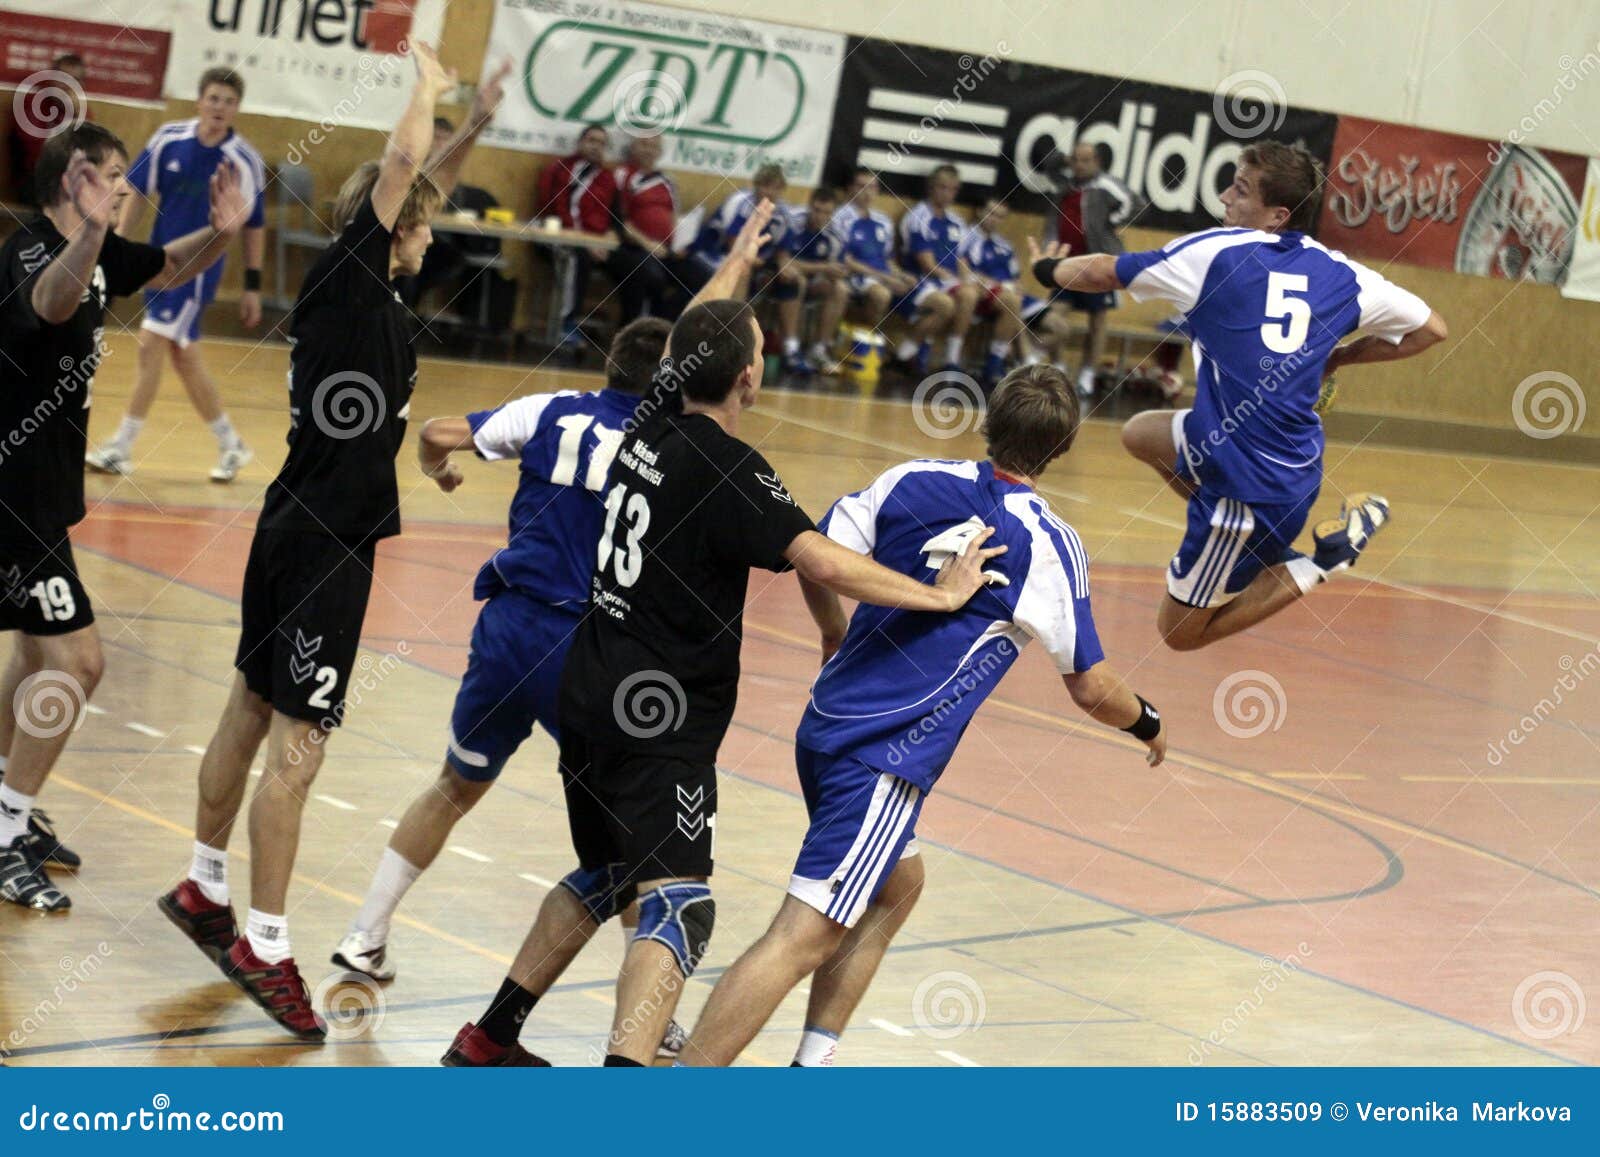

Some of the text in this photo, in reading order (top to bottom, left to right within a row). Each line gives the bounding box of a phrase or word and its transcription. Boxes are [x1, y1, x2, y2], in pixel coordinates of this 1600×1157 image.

[564, 41, 768, 129] ZDT
[1260, 271, 1312, 354] 5
[550, 413, 626, 492] 11
[597, 482, 650, 588] 13
[30, 575, 76, 622] 19
[307, 666, 338, 710] 2
